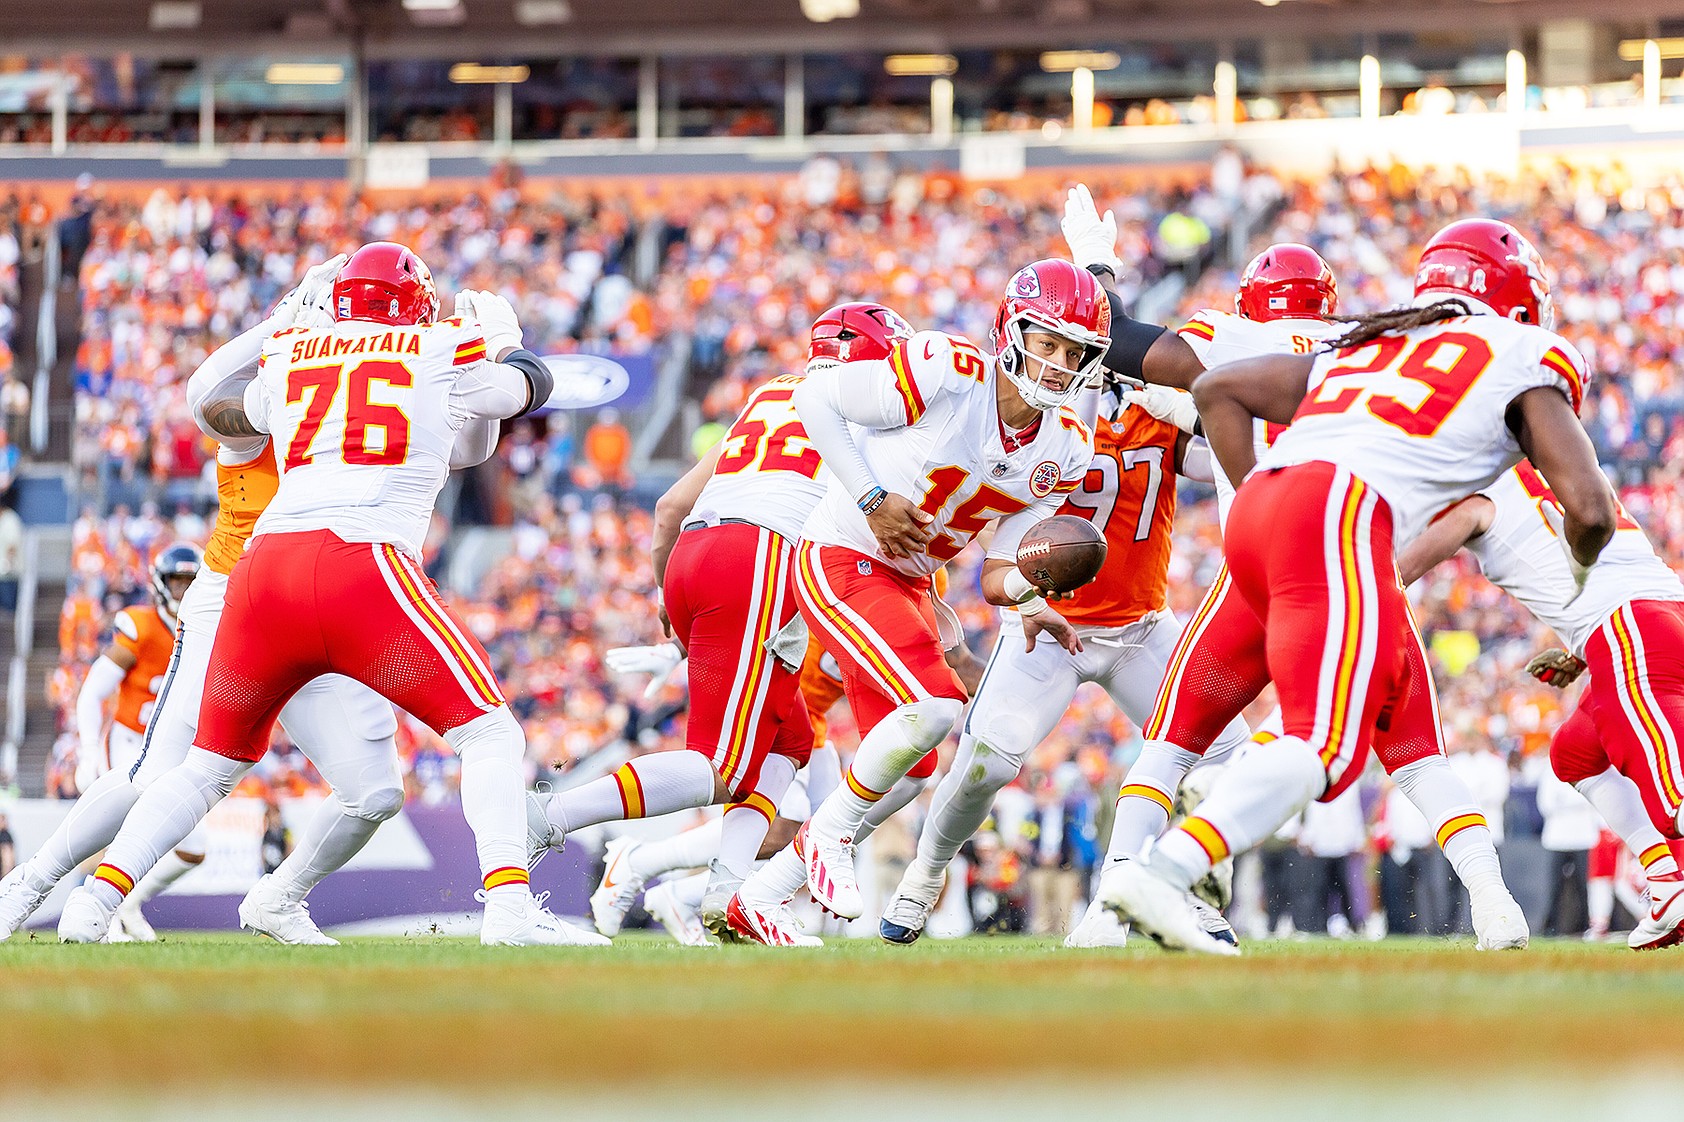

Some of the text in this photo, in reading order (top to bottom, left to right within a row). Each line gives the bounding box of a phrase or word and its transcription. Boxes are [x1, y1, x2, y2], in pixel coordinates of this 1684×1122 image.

[290, 331, 421, 364] SUAMATAIA
[1290, 331, 1495, 438] 29
[284, 359, 414, 474] 76
[714, 388, 824, 480] 52
[917, 464, 1032, 562] 15
[1067, 446, 1167, 543] 97
